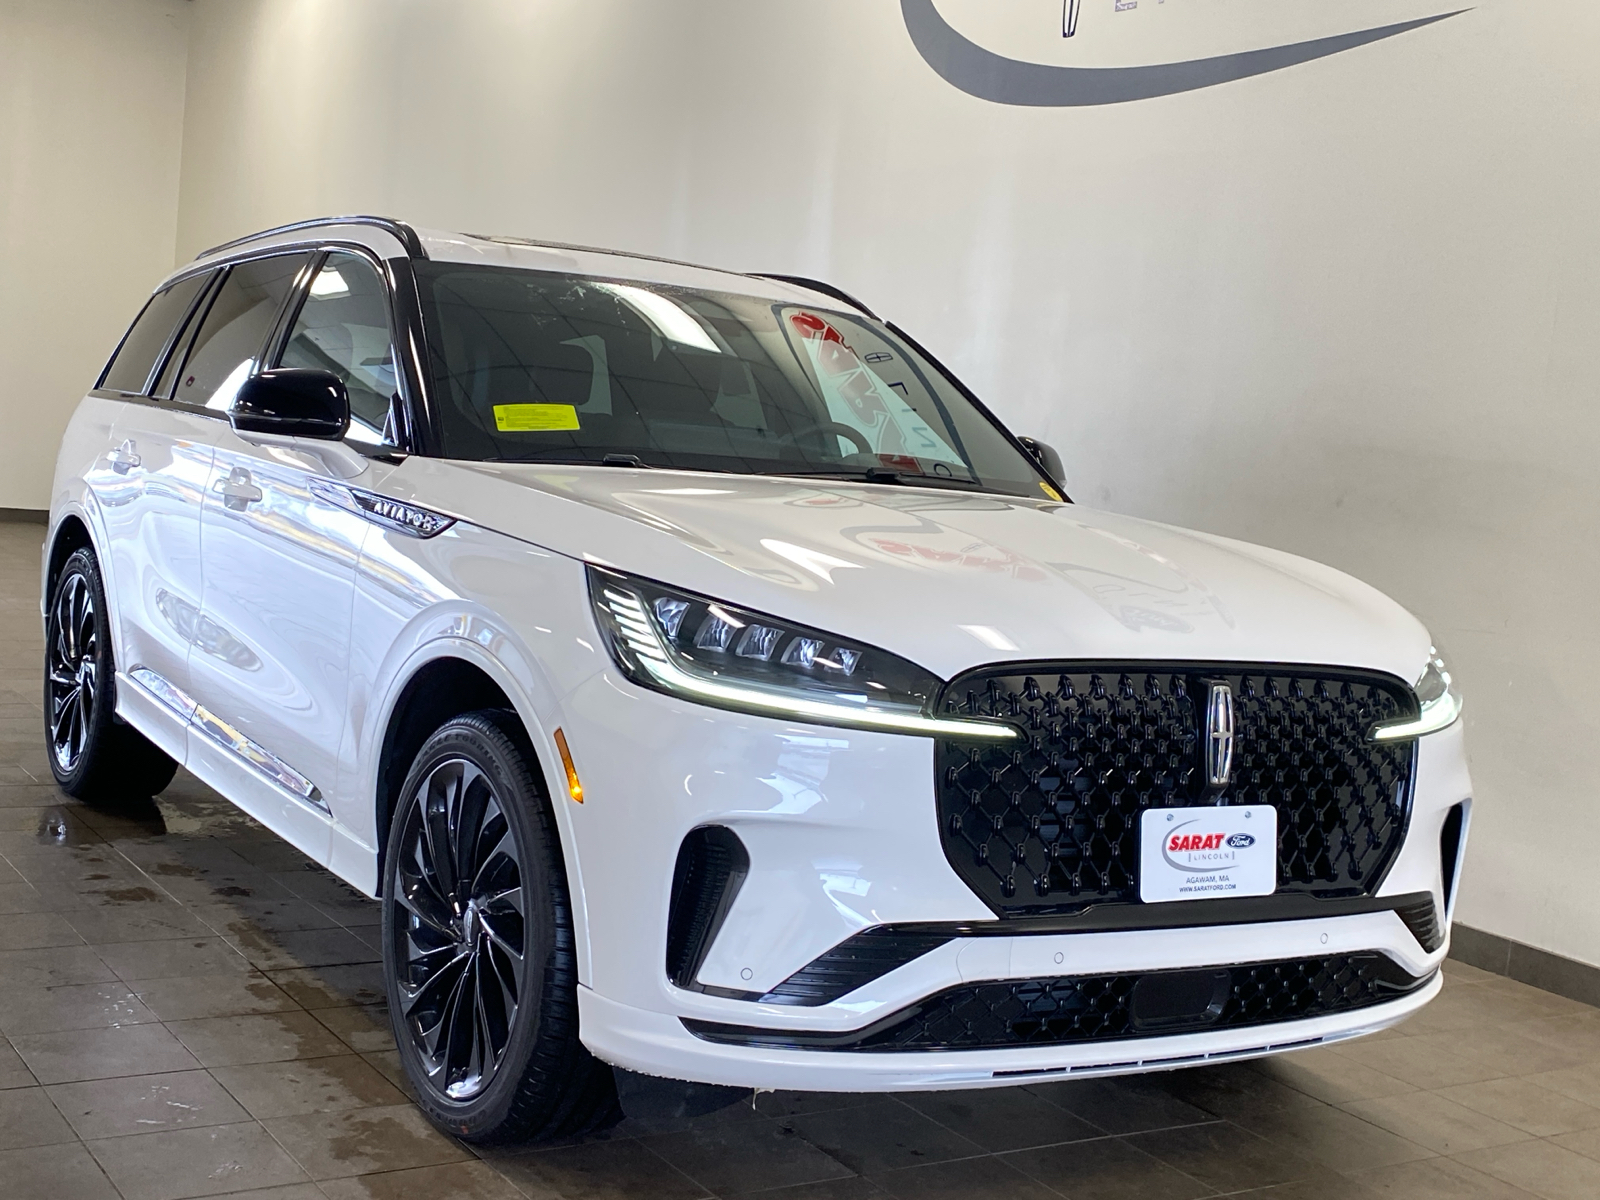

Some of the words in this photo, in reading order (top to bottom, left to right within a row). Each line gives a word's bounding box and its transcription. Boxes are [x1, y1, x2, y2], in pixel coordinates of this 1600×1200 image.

[373, 500, 433, 531] AVIATOR
[1168, 833, 1226, 852] SARAT
[1229, 834, 1252, 847] Ford
[1194, 853, 1229, 861] LINCOLN
[1186, 876, 1217, 884] AGAWAM,
[1179, 884, 1236, 893] WWW.SARATFORD.COM
